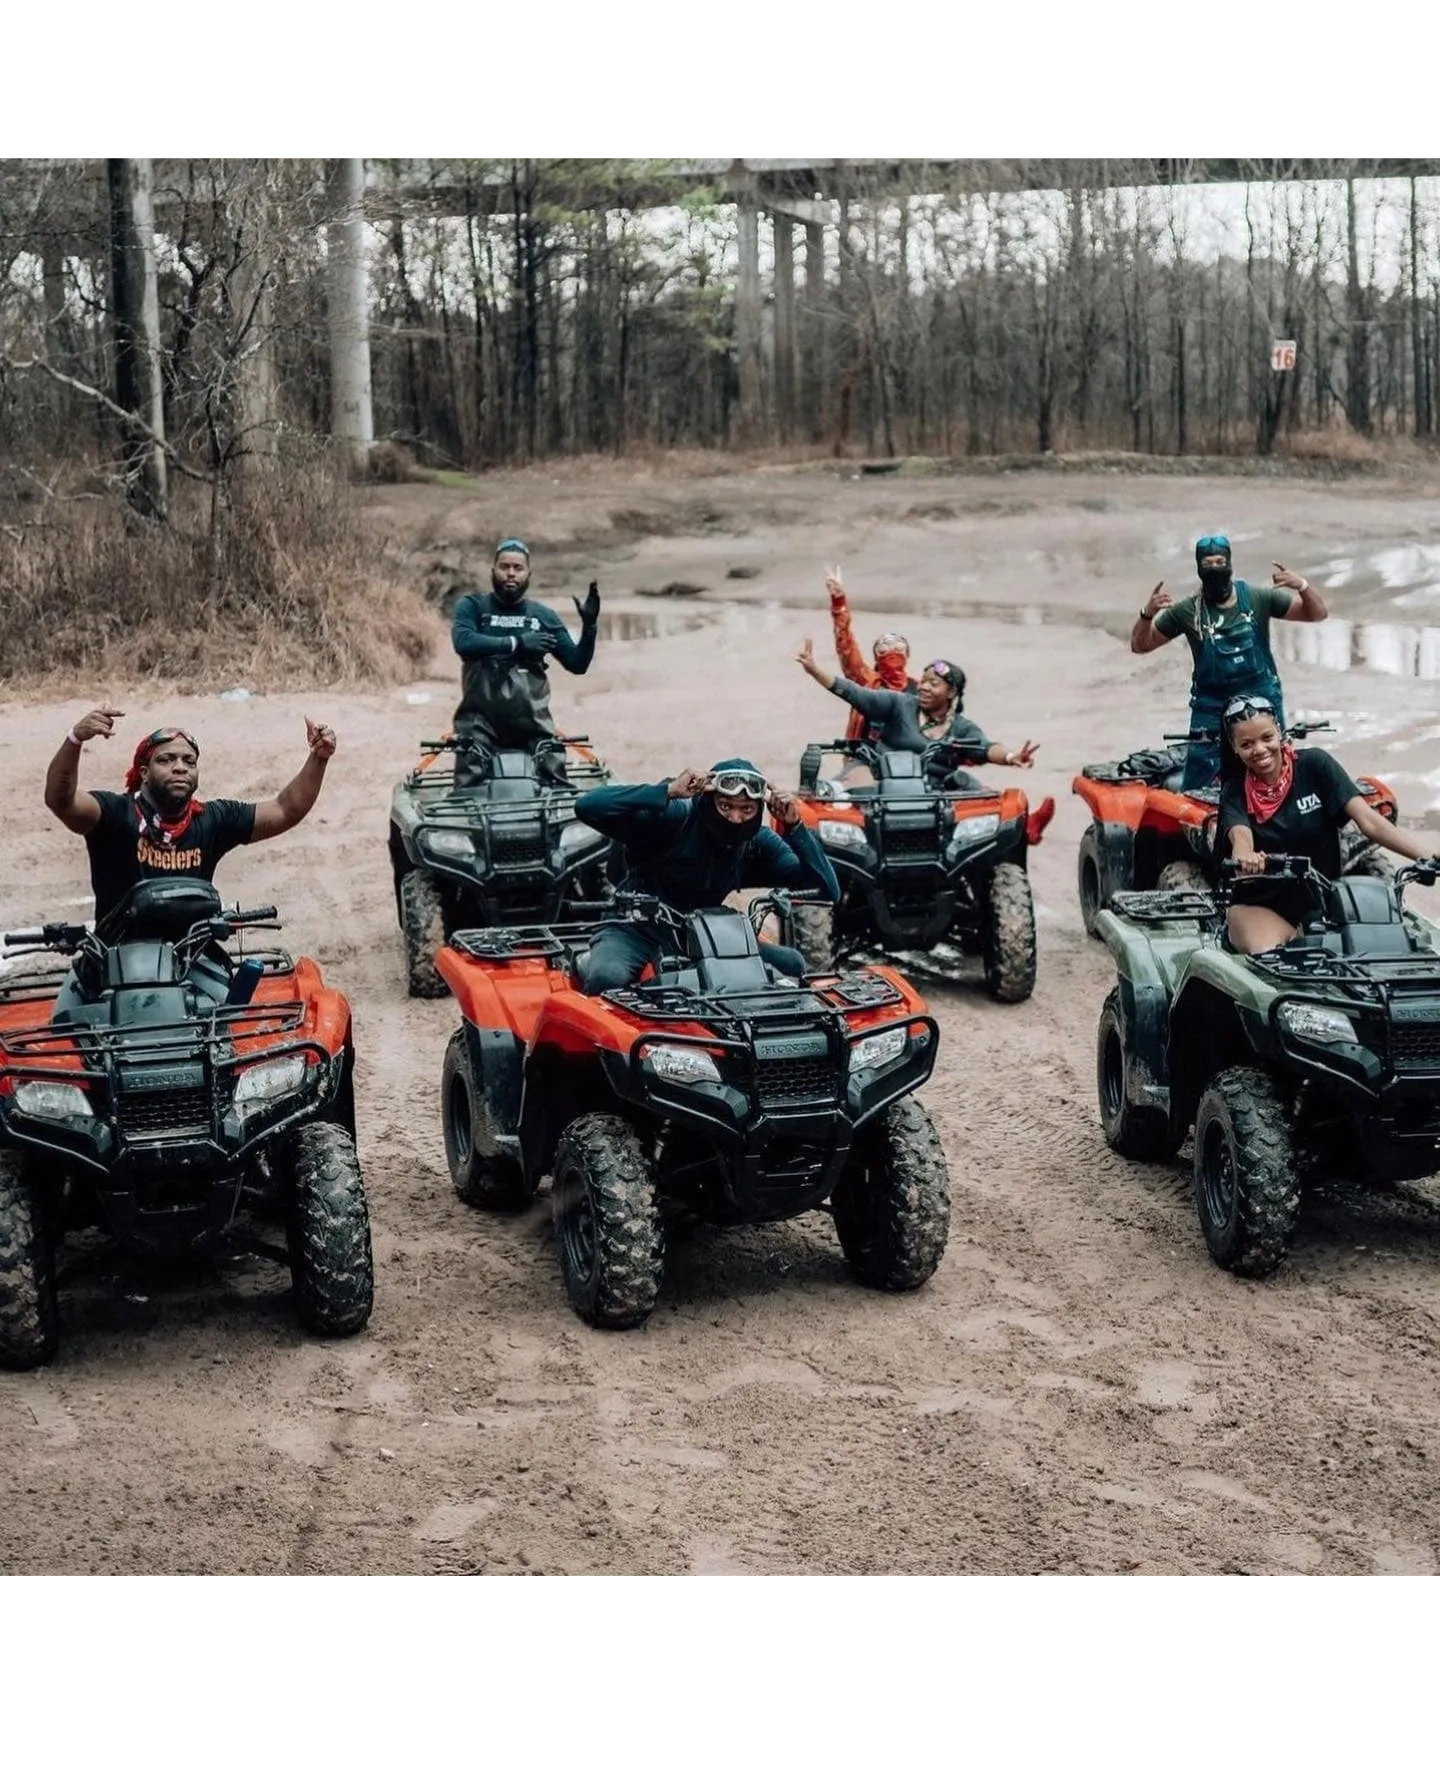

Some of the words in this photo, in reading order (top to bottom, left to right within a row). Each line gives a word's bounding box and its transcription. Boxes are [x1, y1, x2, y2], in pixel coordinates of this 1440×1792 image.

[1274, 348, 1294, 368] 16
[1296, 793, 1321, 810] UTA
[137, 837, 202, 870] Steelers
